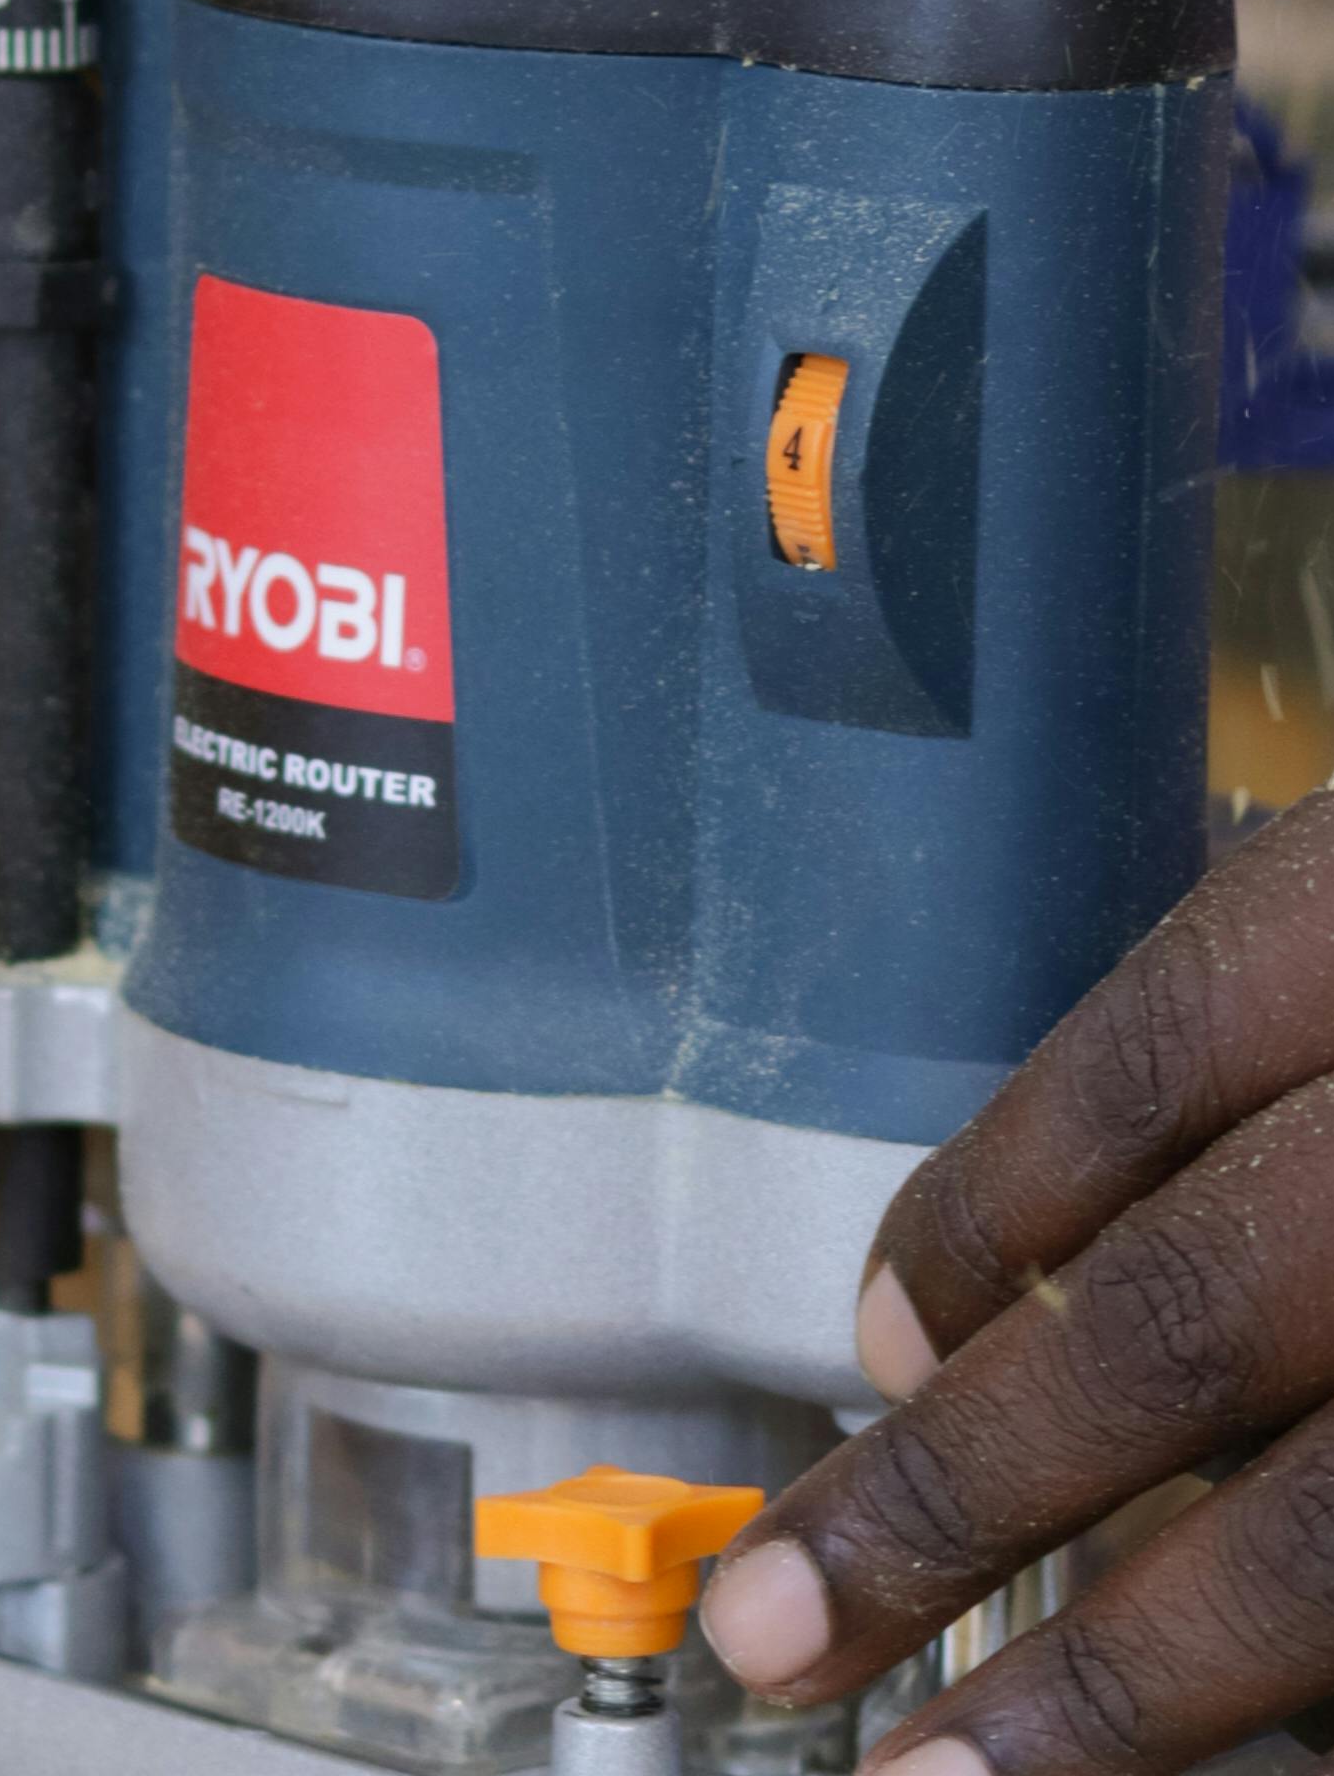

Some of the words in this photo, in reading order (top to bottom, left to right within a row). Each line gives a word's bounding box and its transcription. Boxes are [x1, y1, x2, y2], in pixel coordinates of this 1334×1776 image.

[782, 425, 803, 472] 4
[184, 523, 407, 670] RYOBI
[173, 714, 279, 780] ELECTRIC
[283, 752, 437, 808] ROUTER
[217, 786, 328, 840] RE-1200K
